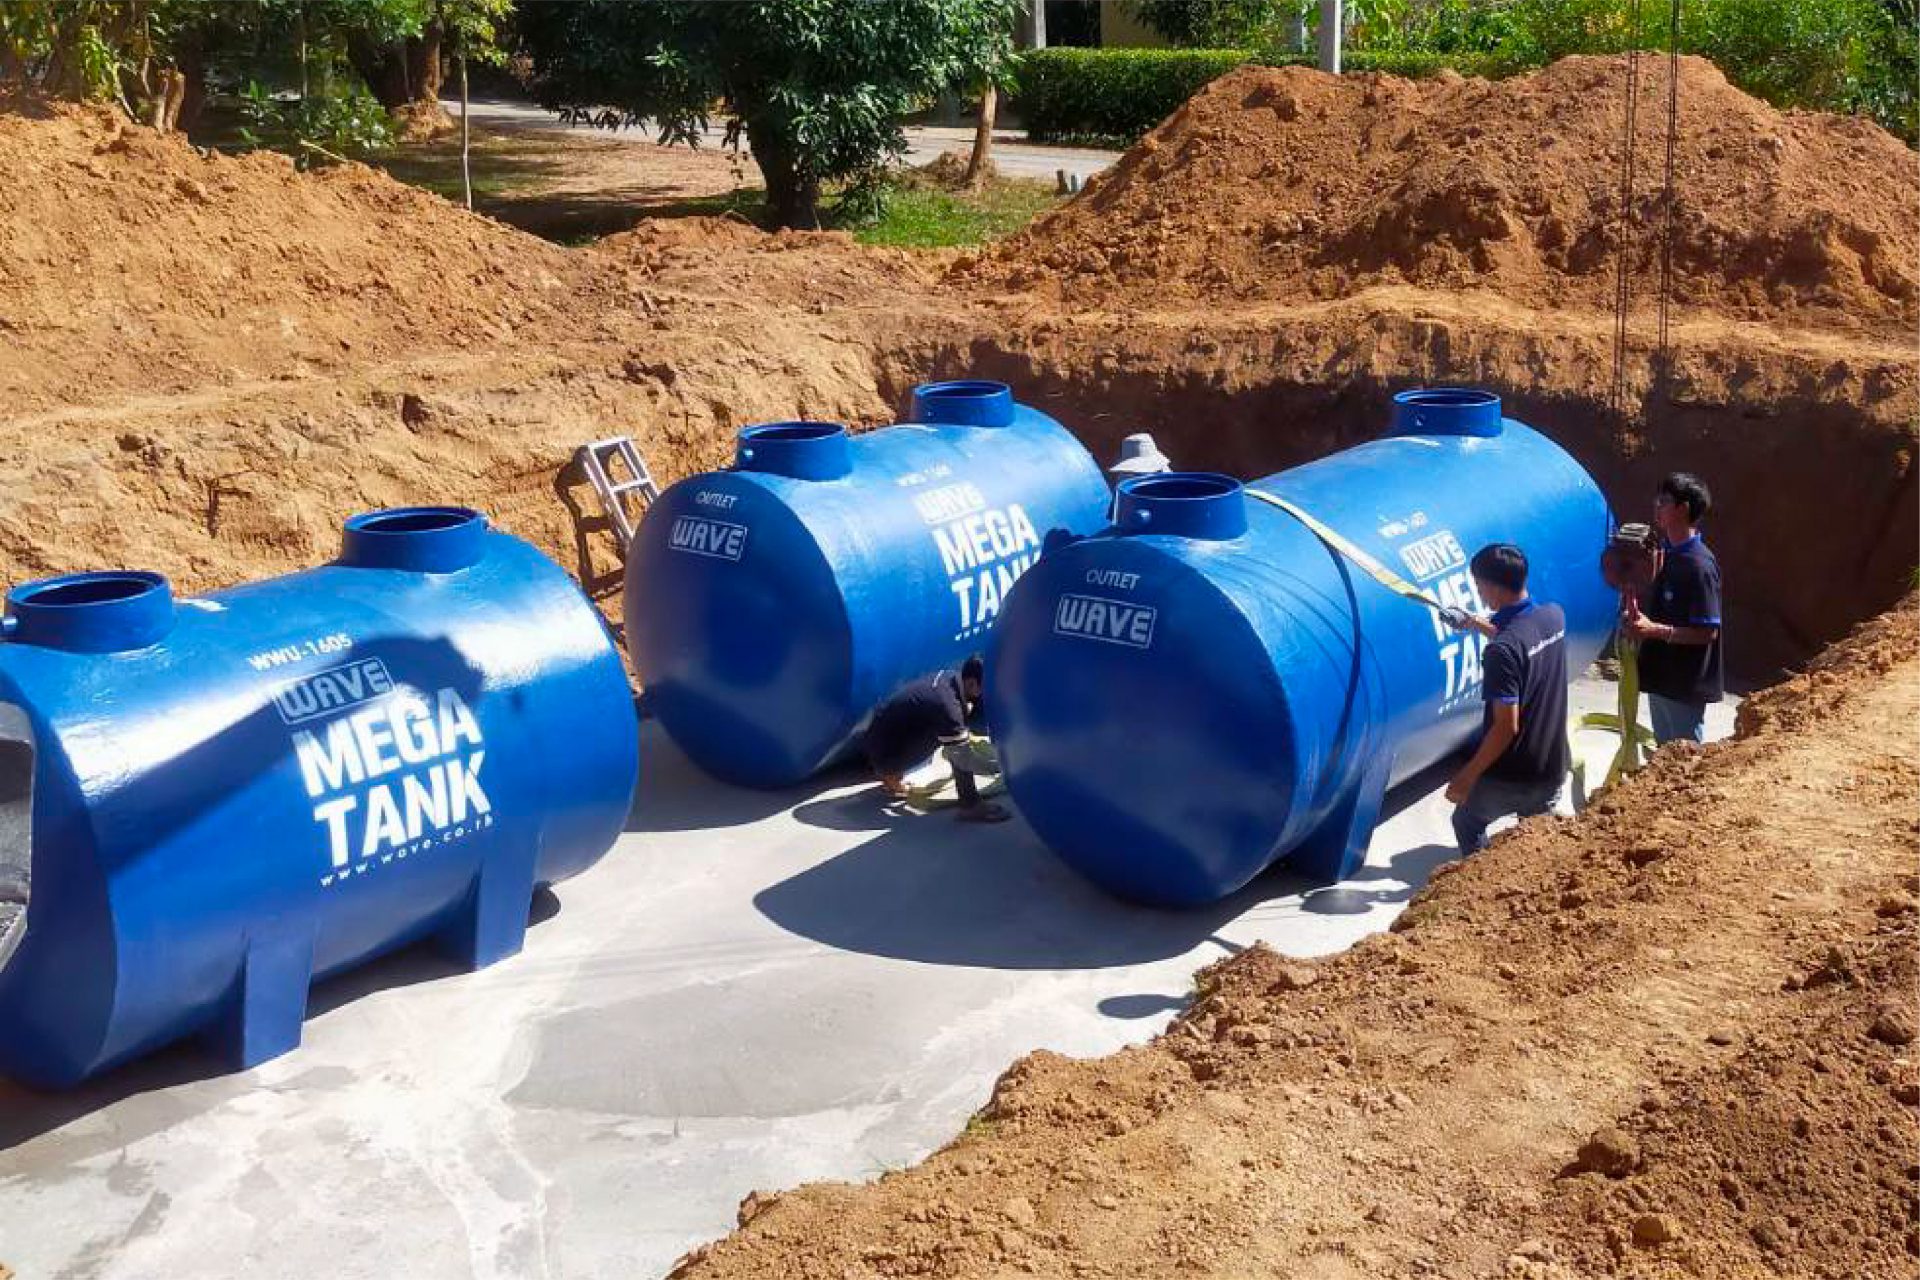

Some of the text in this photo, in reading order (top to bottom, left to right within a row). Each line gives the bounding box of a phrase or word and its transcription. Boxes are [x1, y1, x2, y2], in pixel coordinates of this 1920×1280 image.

[695, 491, 739, 510] OUTLET
[671, 518, 744, 555] WAVE
[931, 503, 1041, 577] MEGA
[1404, 533, 1464, 578] WAVE
[951, 549, 1043, 628] TAN
[1086, 569, 1140, 591] OUTLET
[1421, 566, 1496, 643] ME
[1059, 598, 1153, 643] WAVE
[279, 660, 389, 719] WAVE
[1440, 631, 1488, 701] TA
[291, 686, 483, 797] MEGA
[313, 749, 492, 868] TANK
